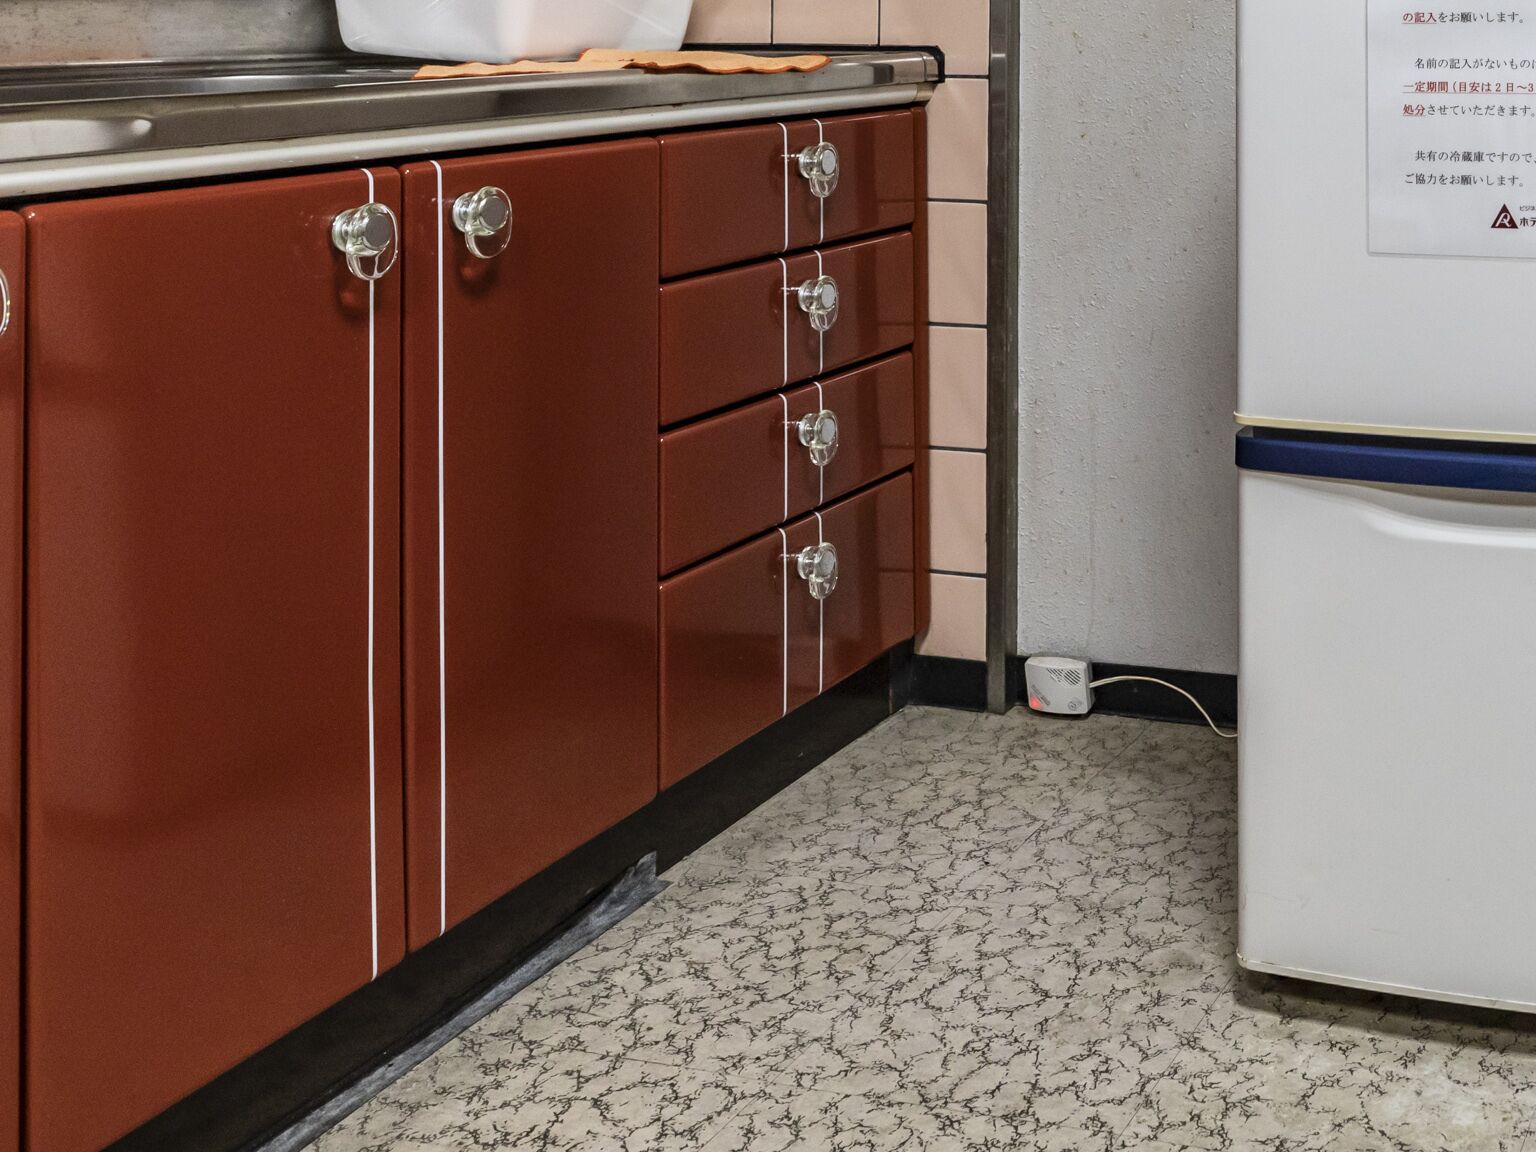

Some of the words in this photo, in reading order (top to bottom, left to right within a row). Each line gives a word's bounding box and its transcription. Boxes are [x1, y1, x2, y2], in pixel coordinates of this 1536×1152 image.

[1402, 11, 1525, 24] の記入をお願いします。
[1402, 103, 1536, 117] 処分させていただきます。
[1404, 173, 1525, 188] ご協力をお願いします。
